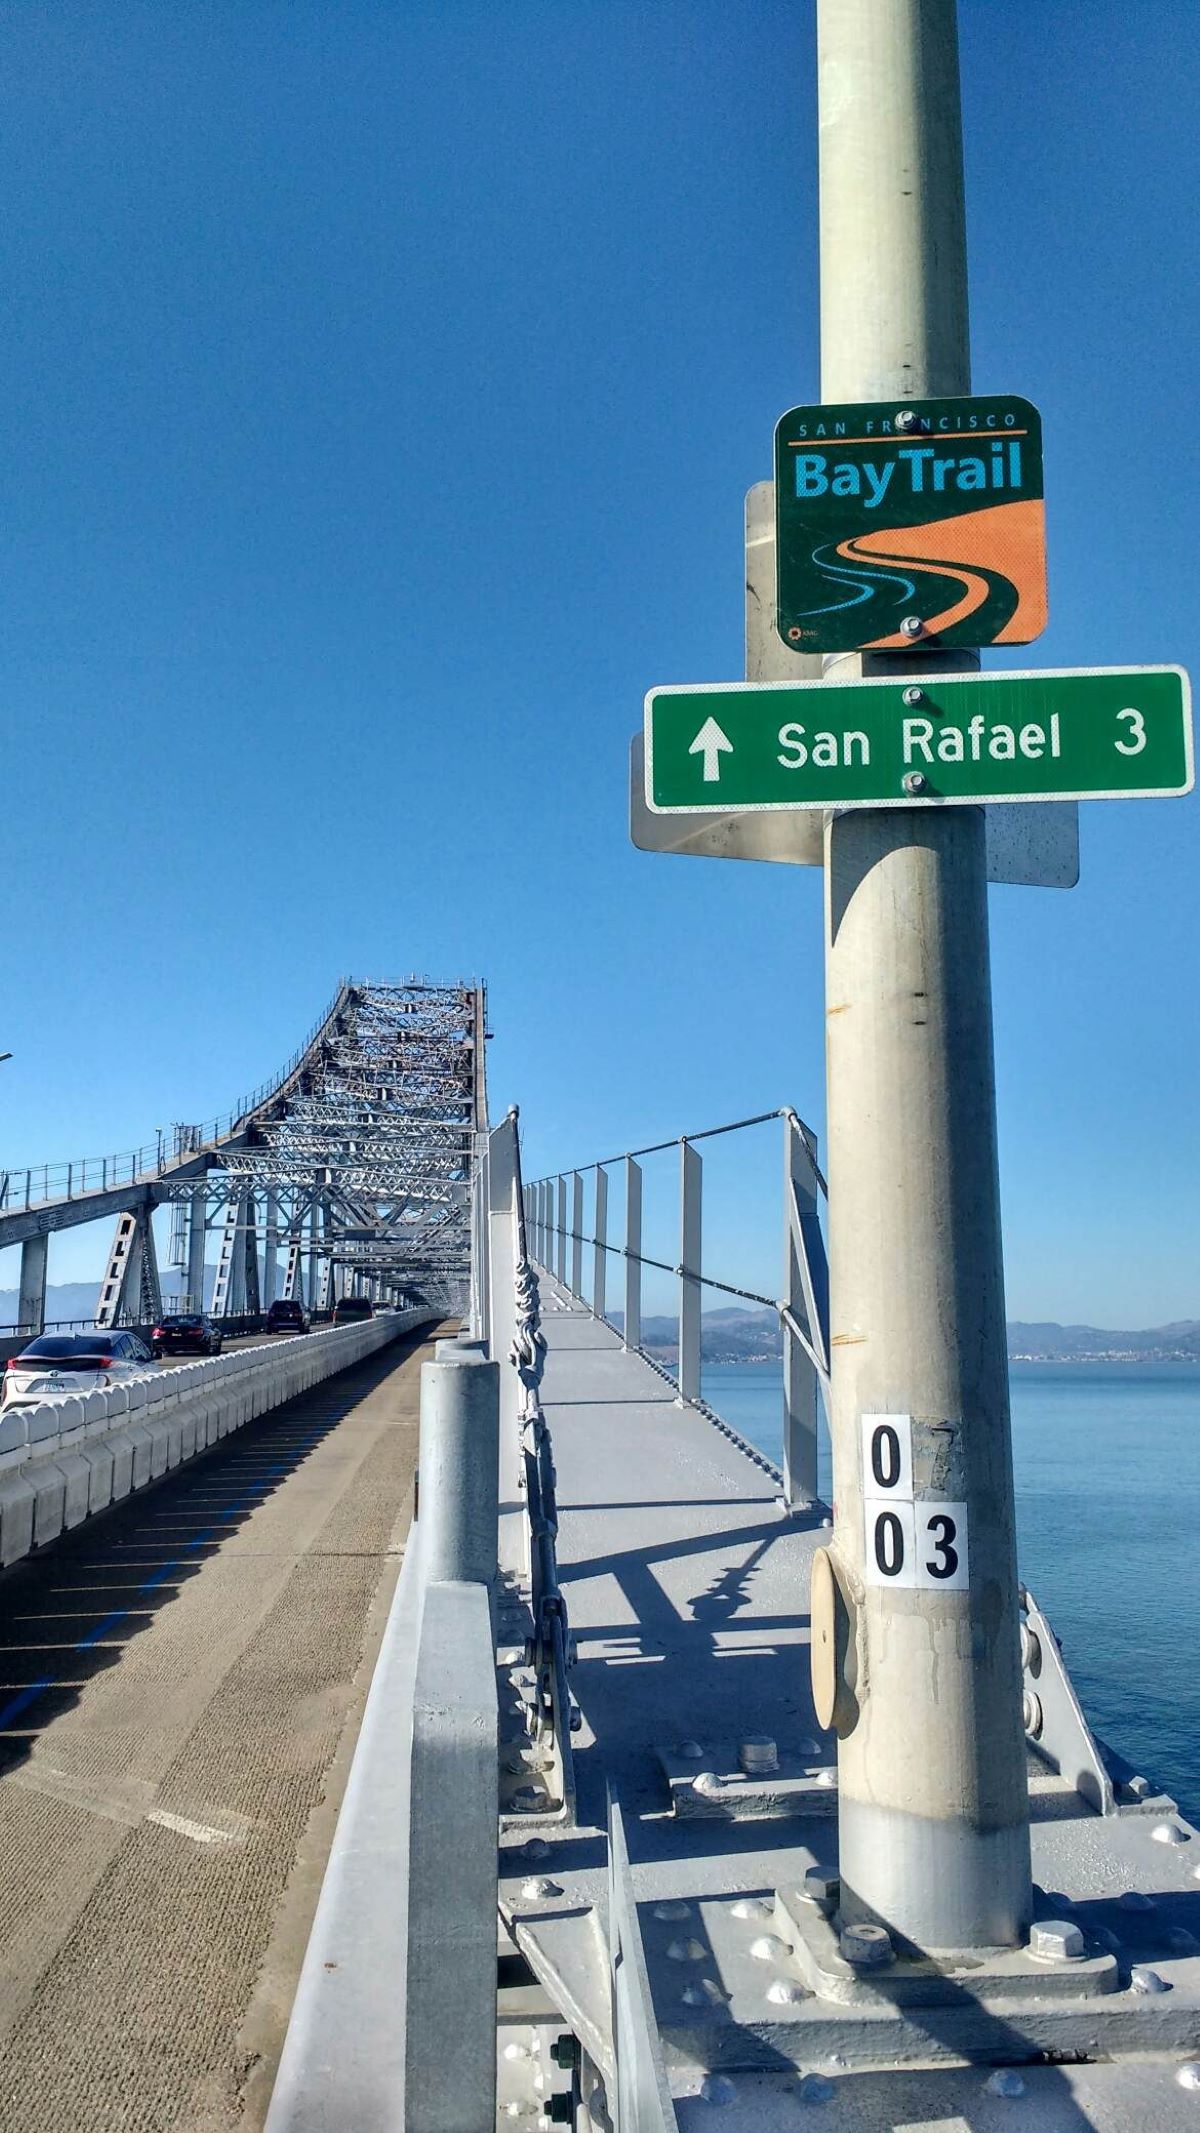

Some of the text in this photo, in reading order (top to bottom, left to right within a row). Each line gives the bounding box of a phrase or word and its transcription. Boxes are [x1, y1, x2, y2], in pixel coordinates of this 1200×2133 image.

[800, 414, 1015, 436] SAN FRNCISCO
[777, 708, 1147, 768] San Rafael 3
[872, 1425, 901, 1488] 0
